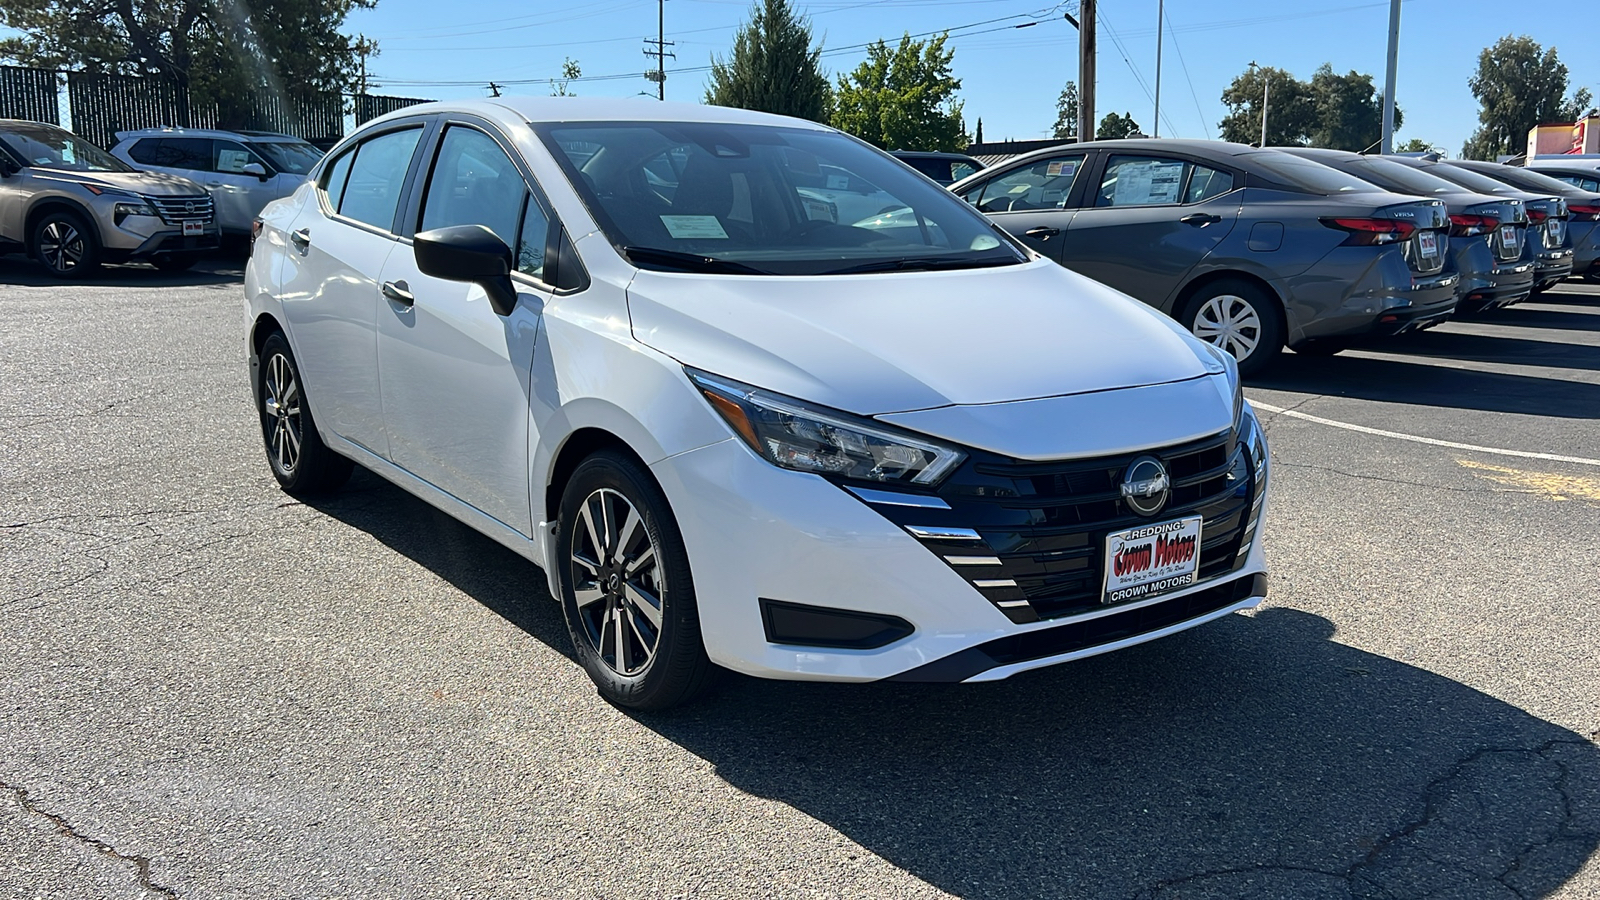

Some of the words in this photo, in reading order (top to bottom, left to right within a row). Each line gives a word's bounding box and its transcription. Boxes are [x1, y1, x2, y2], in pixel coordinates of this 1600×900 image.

[1122, 475, 1170, 495] NISN
[1131, 521, 1182, 540] REDDING
[1113, 541, 1153, 577] Crown
[1154, 532, 1197, 569] Motors
[1174, 564, 1186, 572] Road
[1111, 584, 1149, 602] CROWN
[1150, 574, 1192, 592] MOTORS
